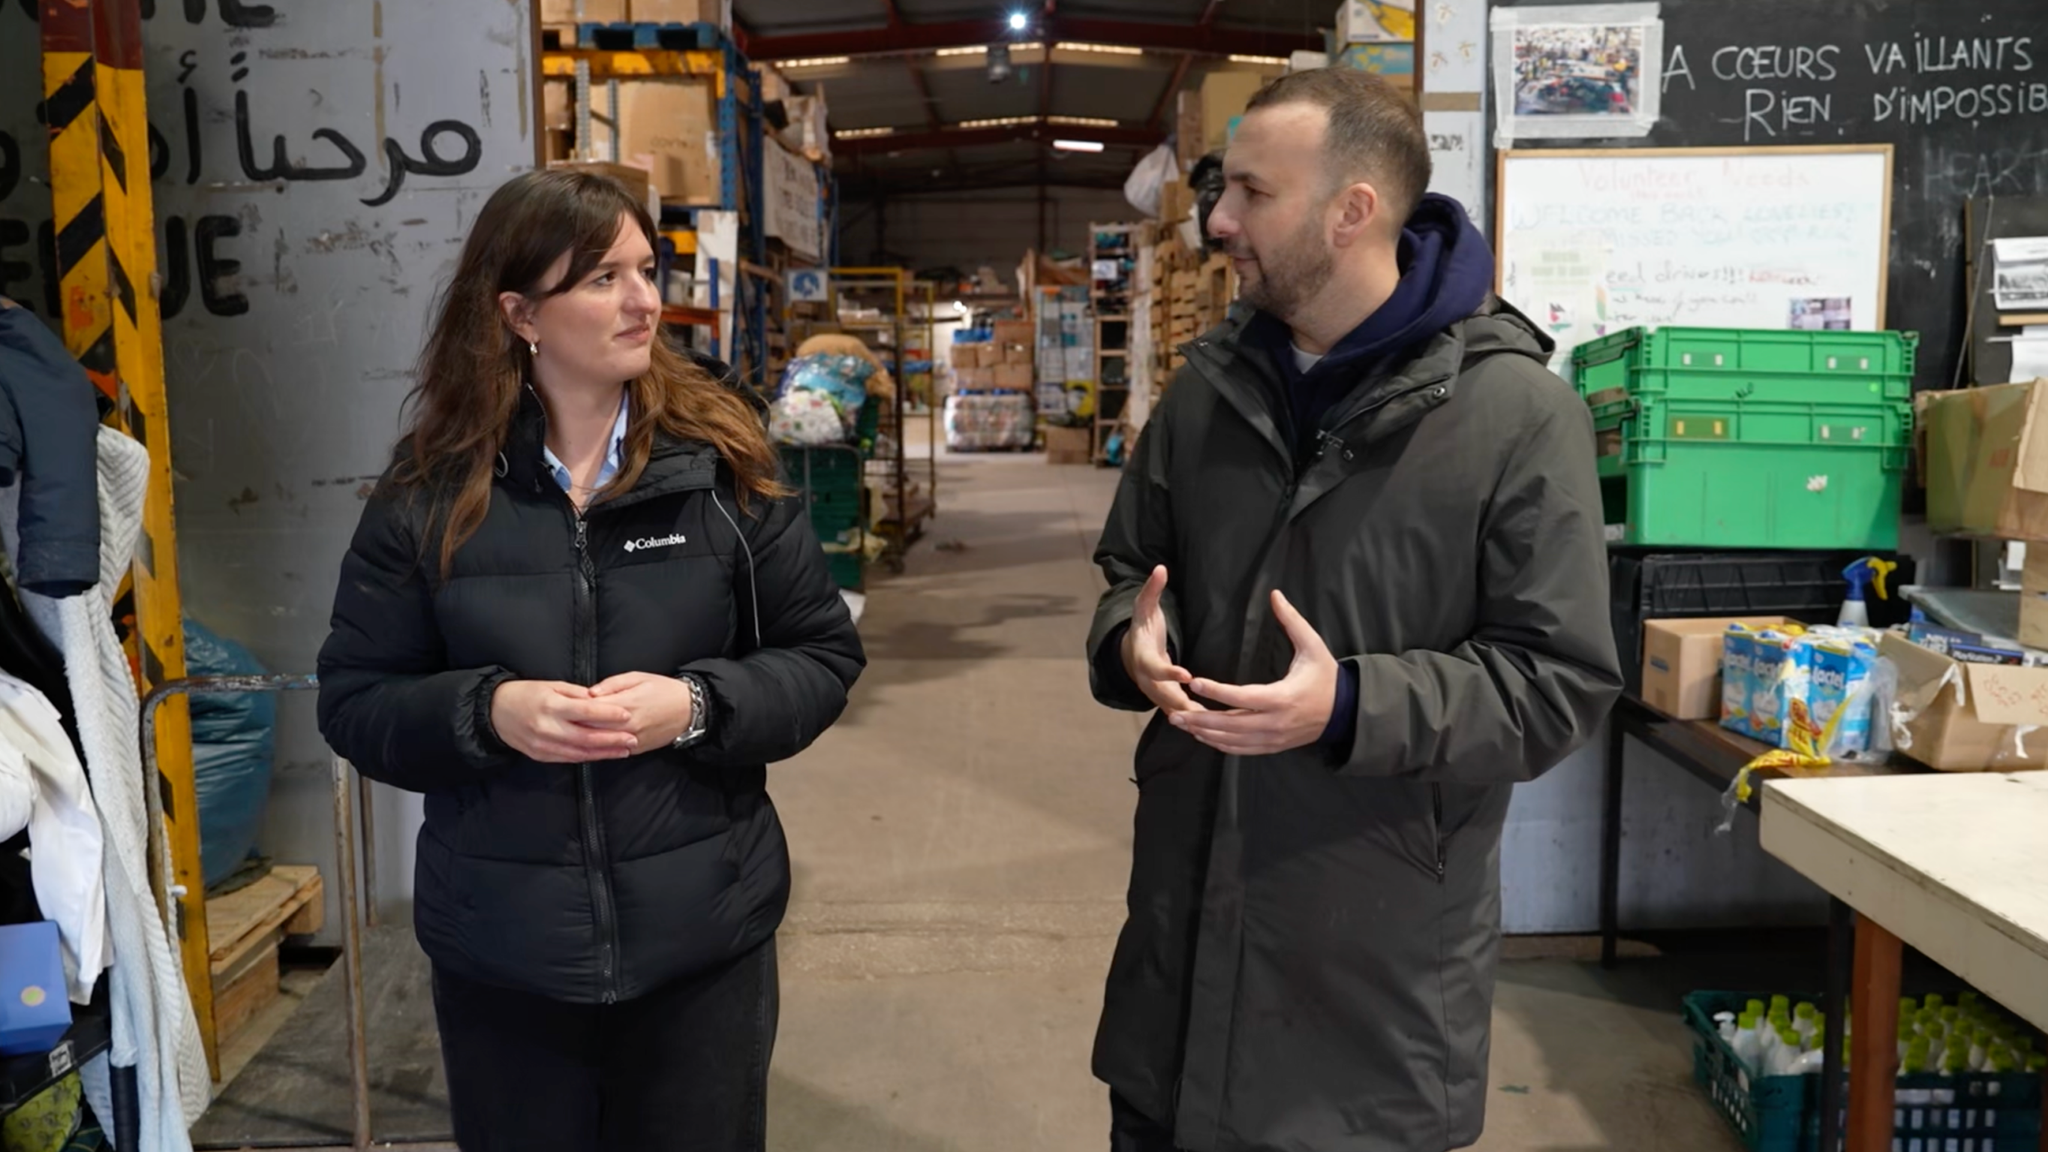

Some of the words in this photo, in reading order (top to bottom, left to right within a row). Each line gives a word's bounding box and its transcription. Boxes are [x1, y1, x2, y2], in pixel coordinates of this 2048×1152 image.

[1662, 45, 1695, 93] A
[1605, 262, 1647, 284] eed
[635, 533, 686, 550] Columbia
